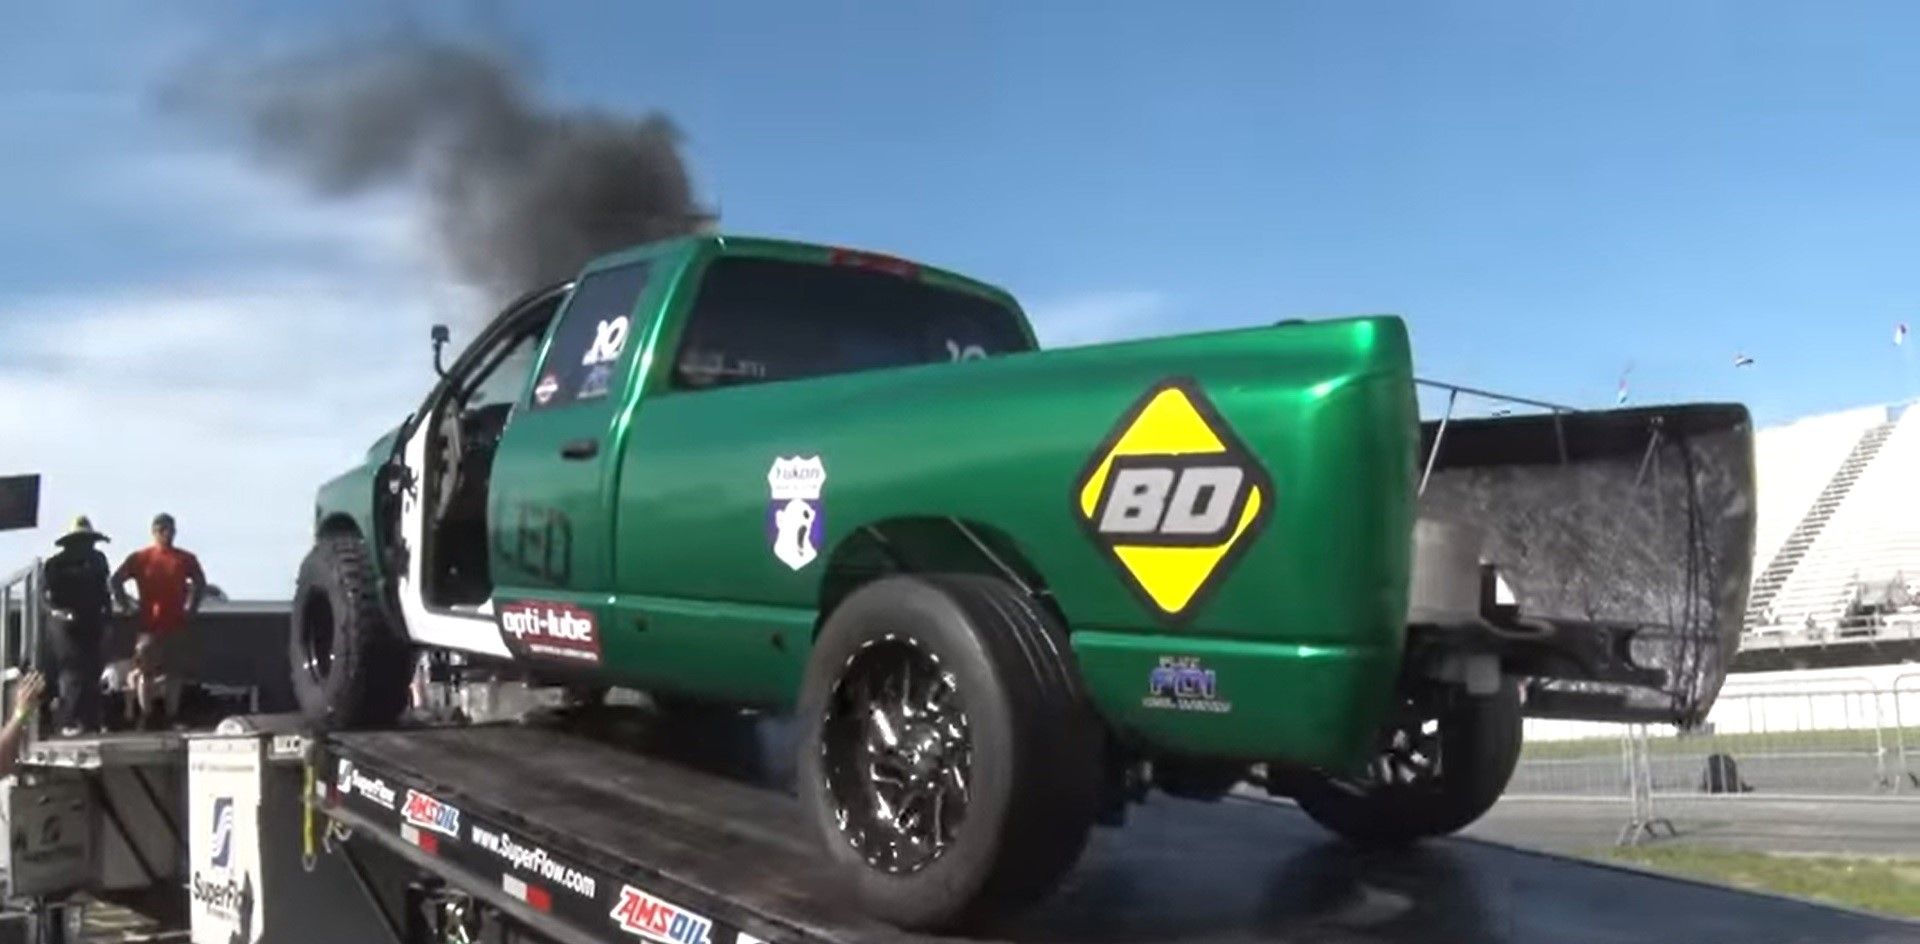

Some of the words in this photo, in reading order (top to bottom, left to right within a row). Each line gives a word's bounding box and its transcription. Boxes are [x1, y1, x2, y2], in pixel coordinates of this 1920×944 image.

[1099, 466, 1244, 534] BD
[502, 607, 592, 642] opti-lube
[403, 791, 459, 836] AMSOIL
[471, 825, 596, 898] www.SuperFlow.com
[193, 870, 247, 912] SuperFl
[616, 887, 711, 944] AMSOIL
